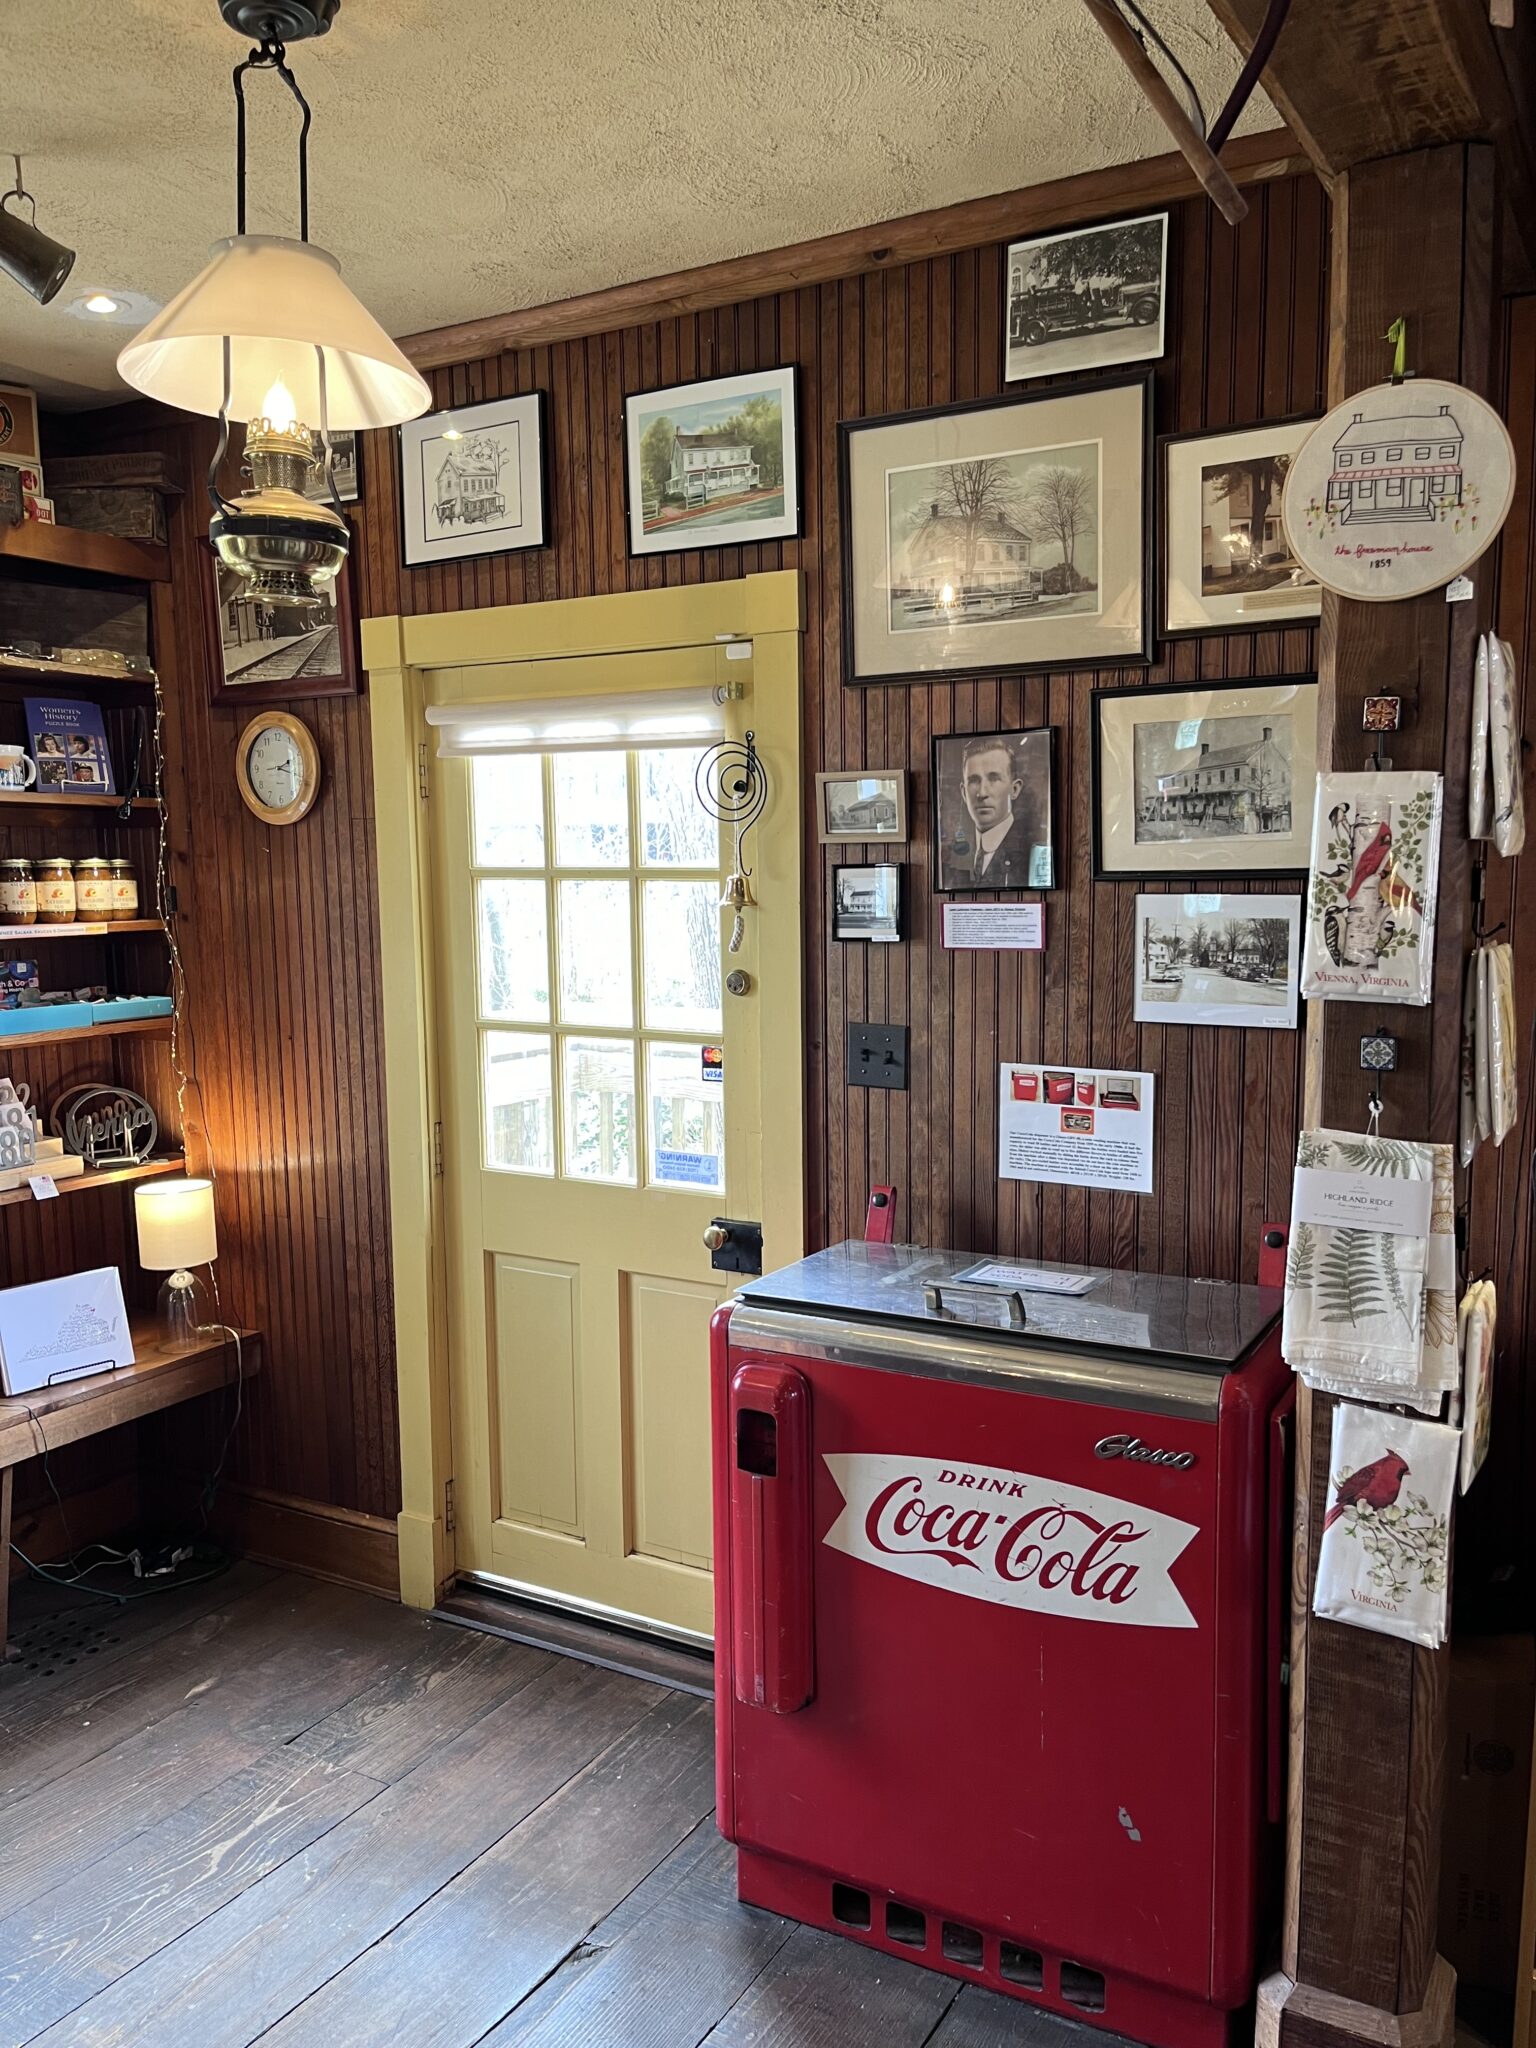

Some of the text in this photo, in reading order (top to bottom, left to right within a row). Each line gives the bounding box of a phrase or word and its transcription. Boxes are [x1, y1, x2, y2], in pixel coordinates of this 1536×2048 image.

[1369, 558, 1392, 569] 1859
[44, 713, 78, 721] History
[263, 738, 270, 747] 11
[274, 732, 281, 742] 12
[256, 749, 264, 759] 10
[267, 790, 273, 800] 7
[1314, 971, 1409, 988] VIENNA, VIRGINIA
[704, 1070, 723, 1078] VISA
[66, 1108, 152, 1149] Vienna
[1323, 1192, 1367, 1205] HIGHLAND
[1369, 1197, 1394, 1208] RIDGE
[1093, 1433, 1196, 1471] Glasco
[936, 1469, 1028, 1499] DRINK
[864, 1475, 1152, 1605] Coca-Cola
[1350, 1588, 1398, 1613] VIRGINIA
